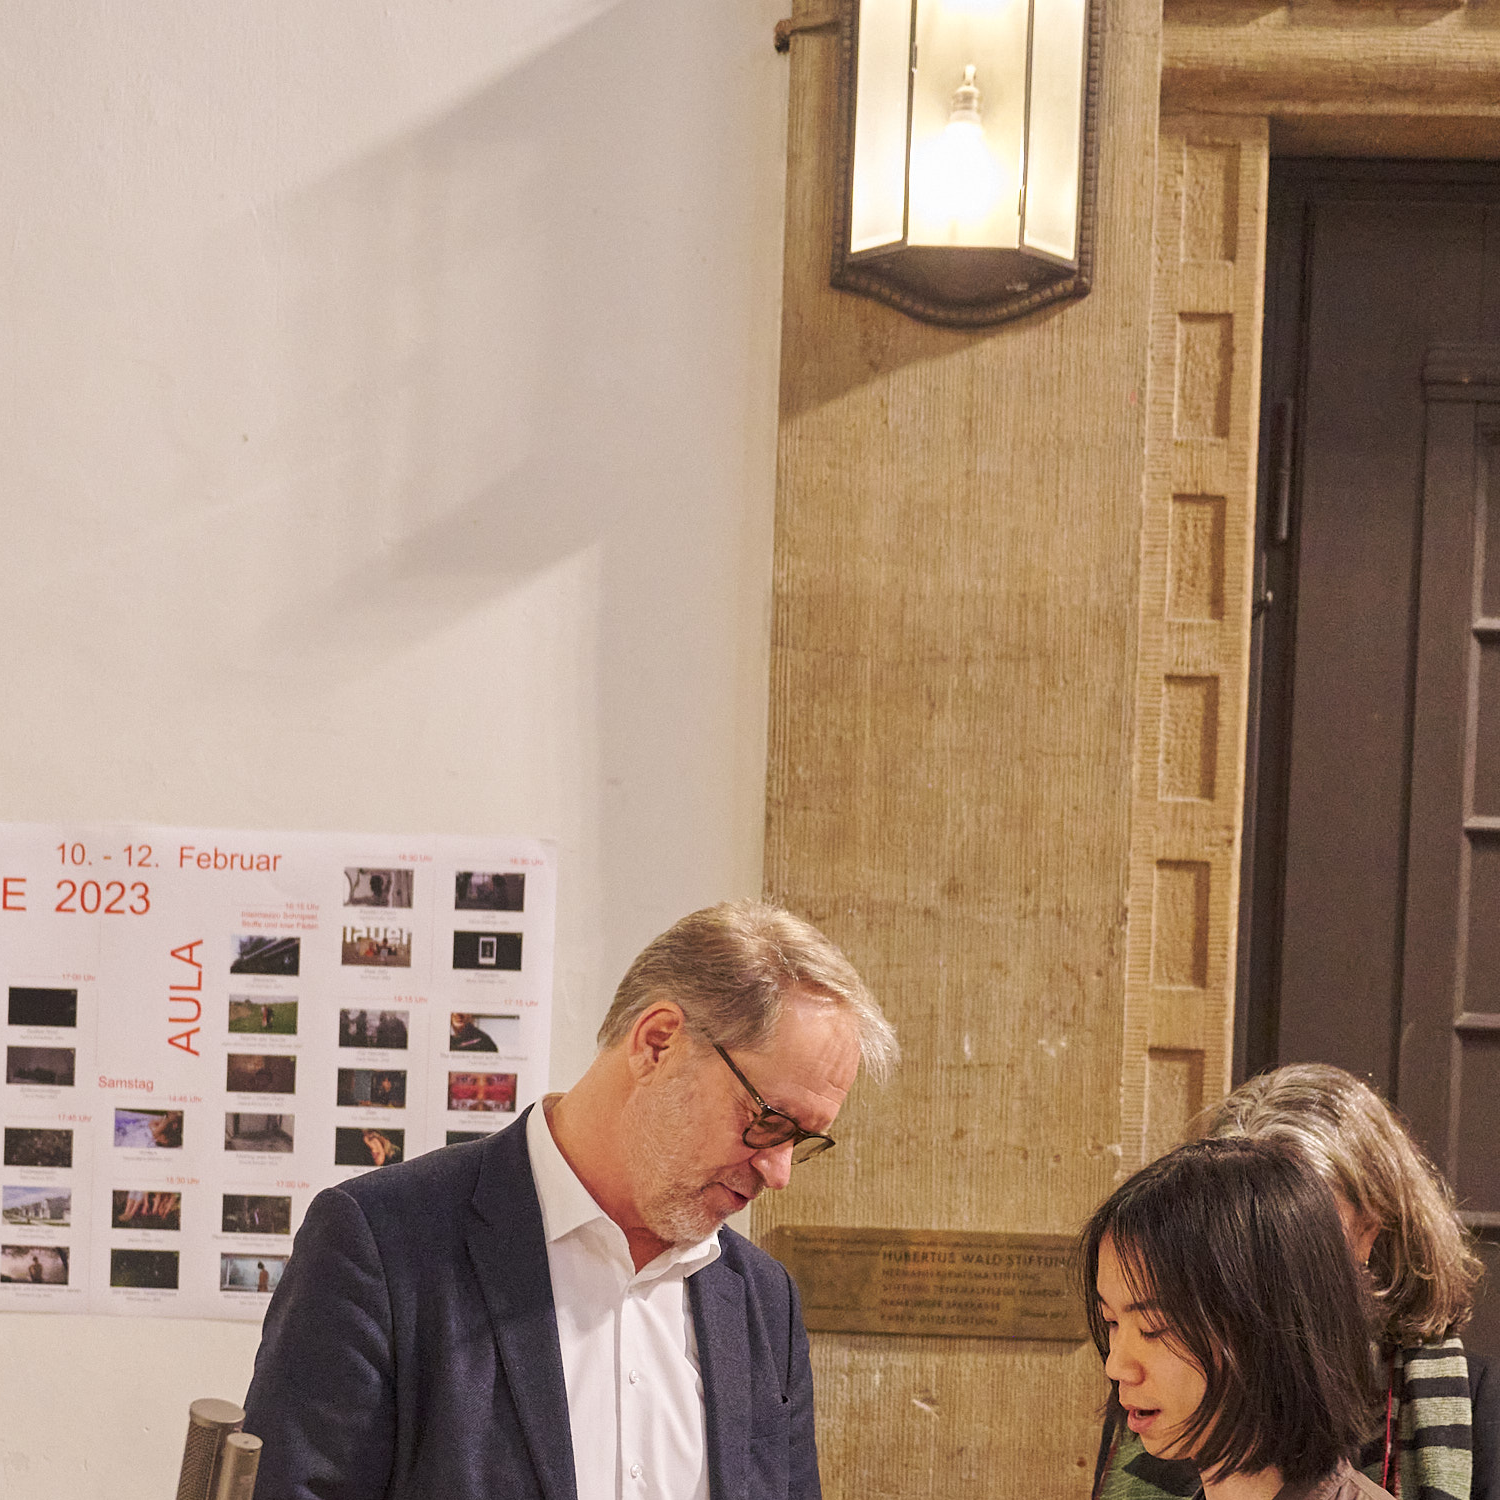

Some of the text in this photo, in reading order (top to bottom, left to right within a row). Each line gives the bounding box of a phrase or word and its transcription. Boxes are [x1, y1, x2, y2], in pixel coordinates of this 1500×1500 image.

[56, 842, 93, 866] 10.
[123, 844, 160, 868] 12.
[179, 845, 283, 872] Februar
[54, 879, 151, 916] 2023
[168, 939, 204, 1057] AULA
[98, 1075, 155, 1093] Samstag
[961, 1253, 1001, 1266] WALD
